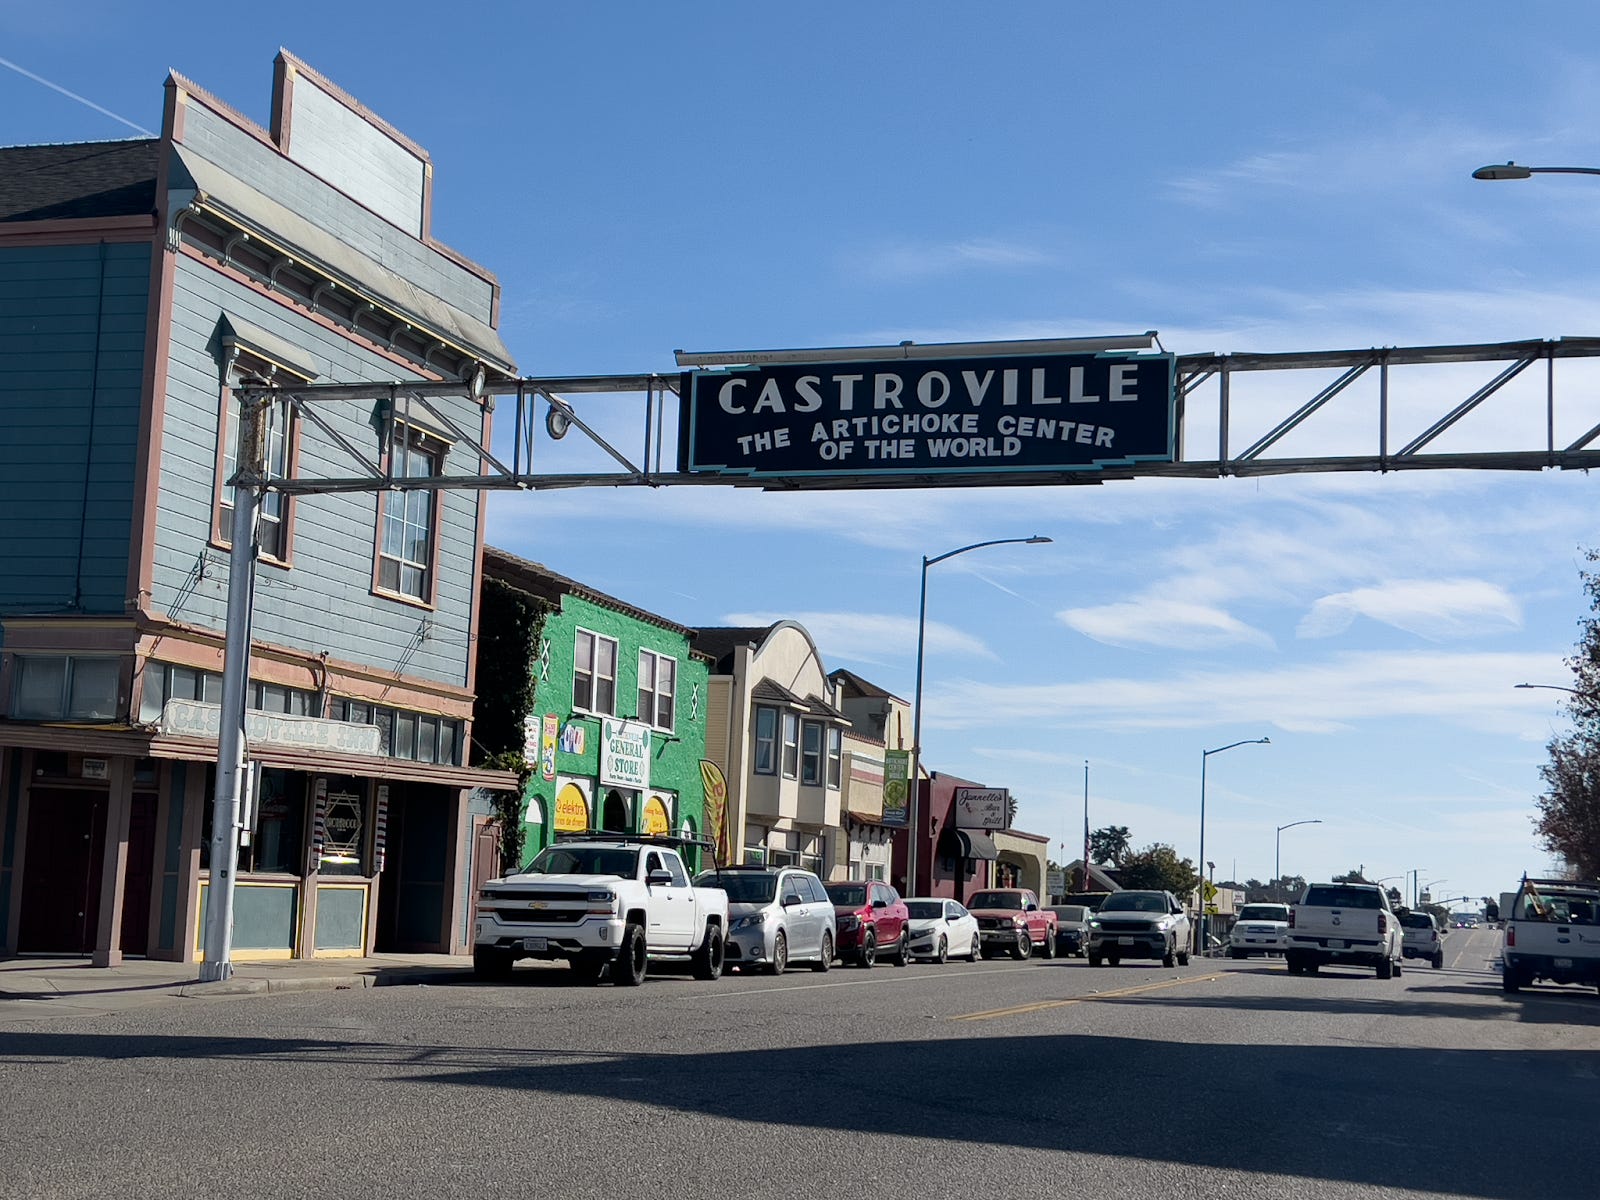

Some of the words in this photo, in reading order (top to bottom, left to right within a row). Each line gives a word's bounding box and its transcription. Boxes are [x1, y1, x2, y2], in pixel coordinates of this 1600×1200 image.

[718, 364, 1138, 414] CASTROVILLE
[737, 428, 791, 455] THE
[811, 413, 979, 442] ARTICHOKE
[997, 415, 1115, 448] CENTER
[819, 441, 854, 460] OF
[864, 439, 915, 459] THE
[927, 436, 1022, 458] WORLD
[175, 705, 329, 745] CASOVILLE
[336, 727, 375, 750] INN
[610, 739, 643, 758] GENERAL
[615, 758, 639, 775] STORE
